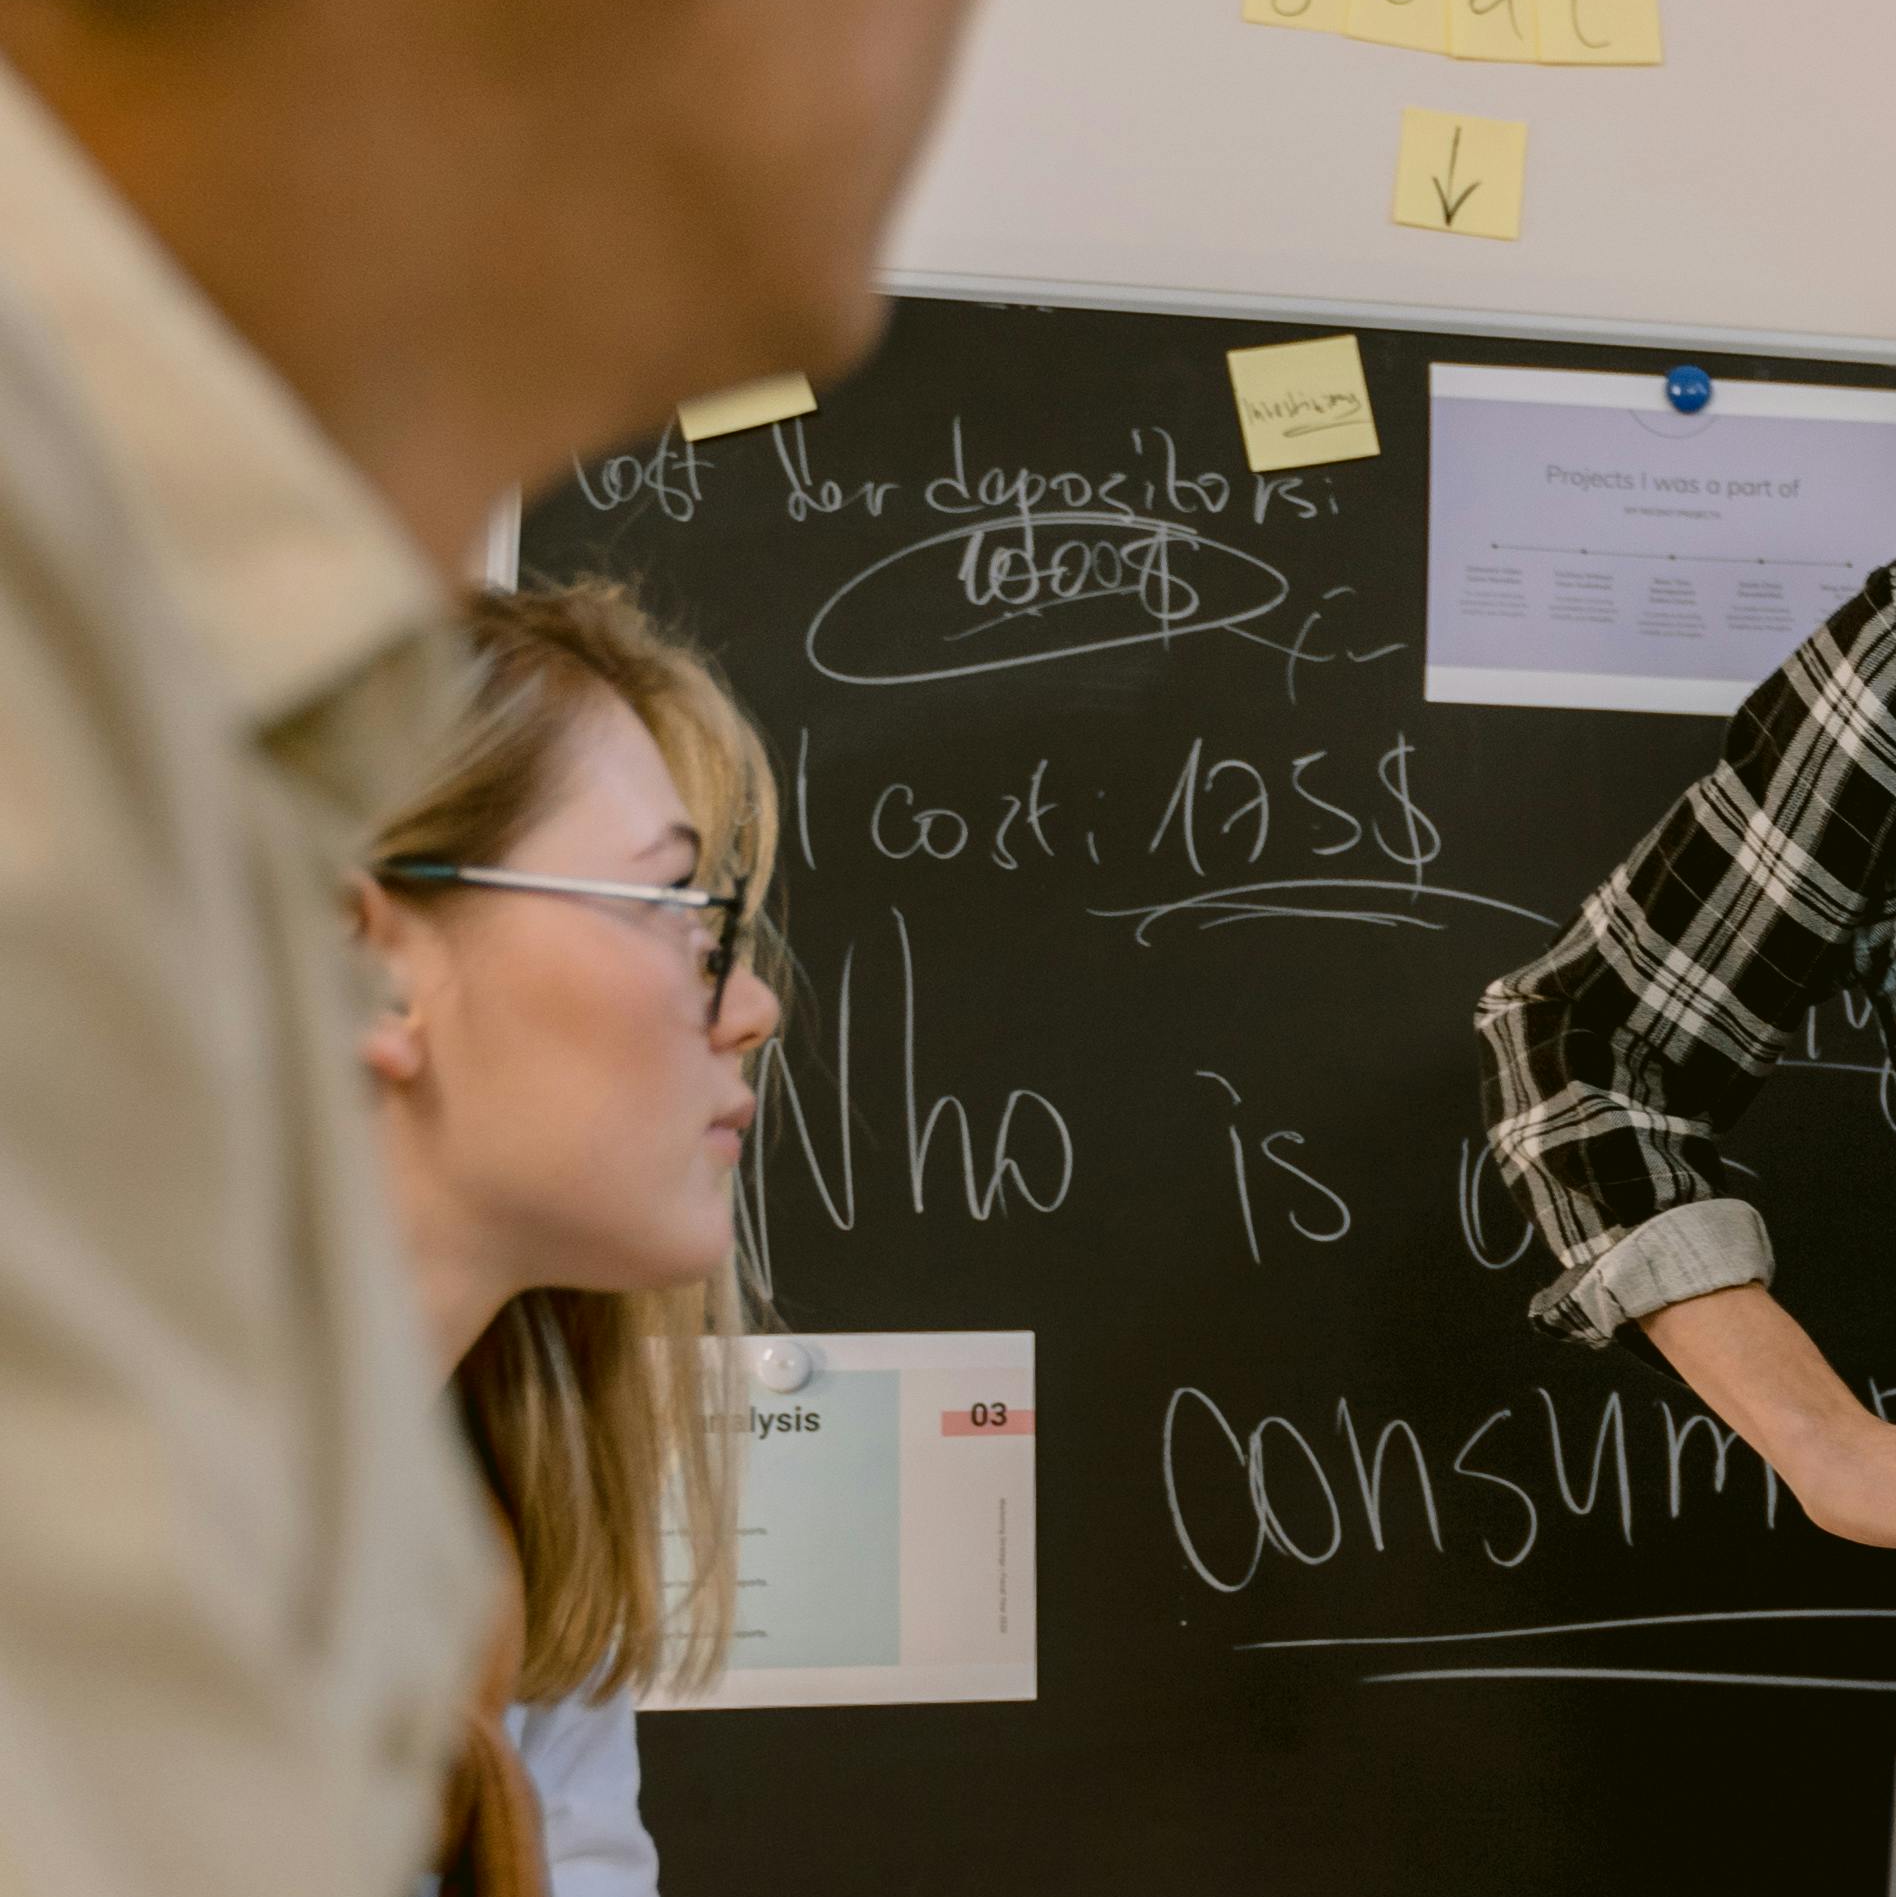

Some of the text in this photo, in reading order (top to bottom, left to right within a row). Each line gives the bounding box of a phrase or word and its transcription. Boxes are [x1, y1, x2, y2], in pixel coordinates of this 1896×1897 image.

[1545, 464, 1635, 491] Projects
[1653, 476, 1700, 495] was
[1705, 479, 1721, 496] a
[1726, 477, 1772, 501] part
[1777, 476, 1802, 499] of
[1149, 730, 1441, 903] 175$
[1195, 1070, 1352, 1264] is
[970, 1402, 1008, 1428] 03
